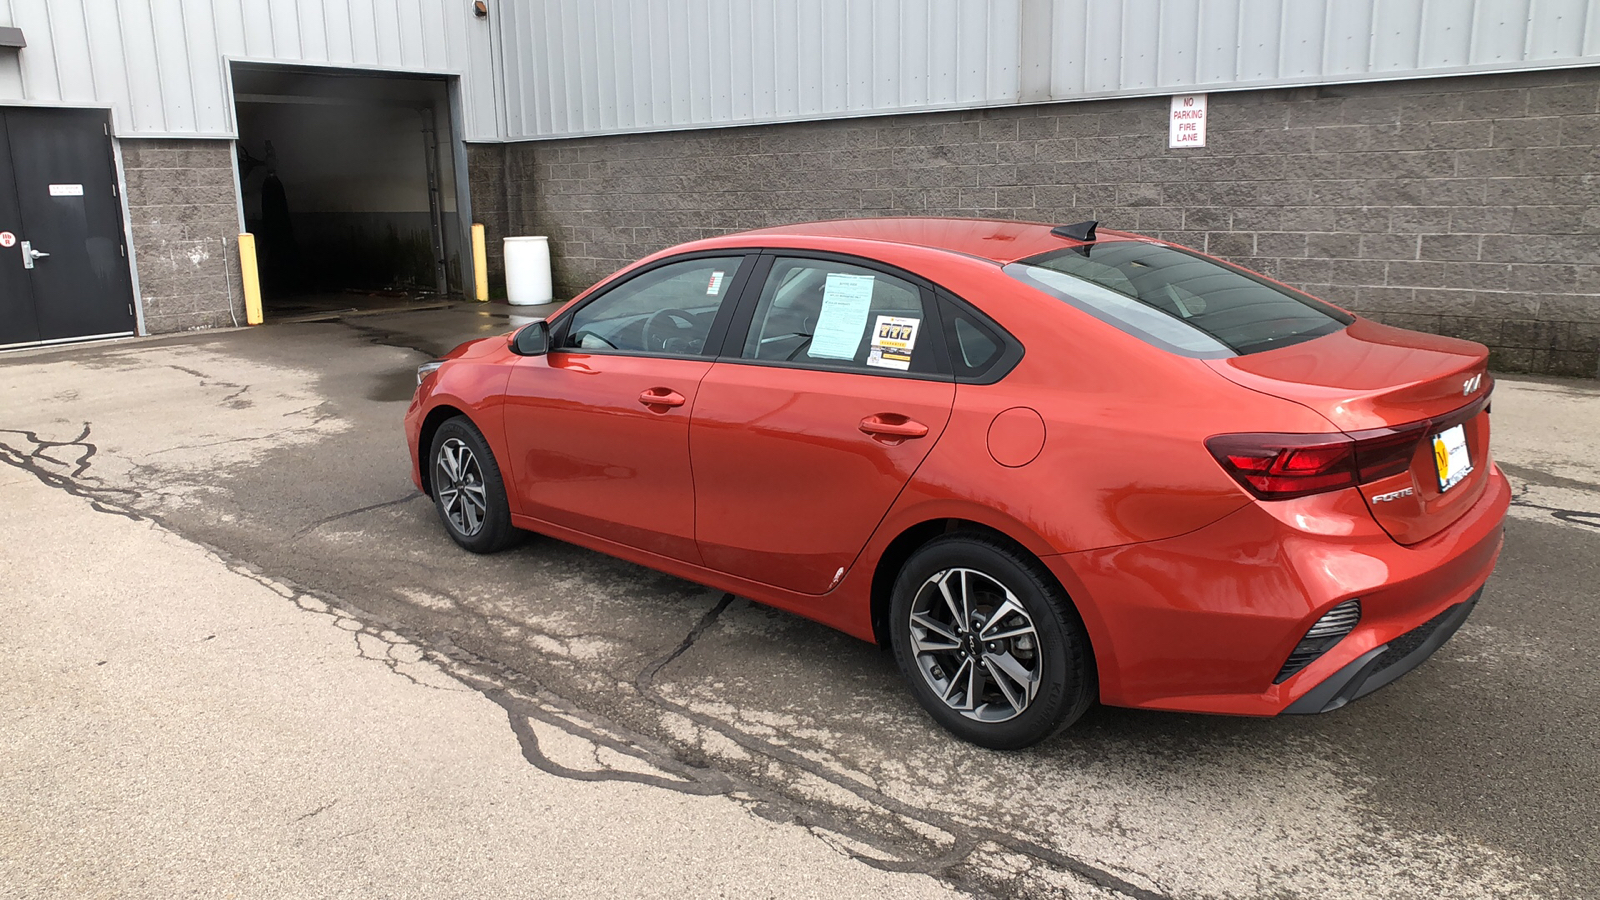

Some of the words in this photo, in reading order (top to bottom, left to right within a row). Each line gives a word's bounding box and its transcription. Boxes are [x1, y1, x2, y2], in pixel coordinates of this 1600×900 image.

[1183, 97, 1193, 106] NO
[1174, 110, 1202, 119] PARKING
[1179, 122, 1196, 131] FIRE
[1176, 133, 1198, 142] LANE
[1436, 447, 1448, 471] M
[1372, 487, 1413, 504] FORTE
